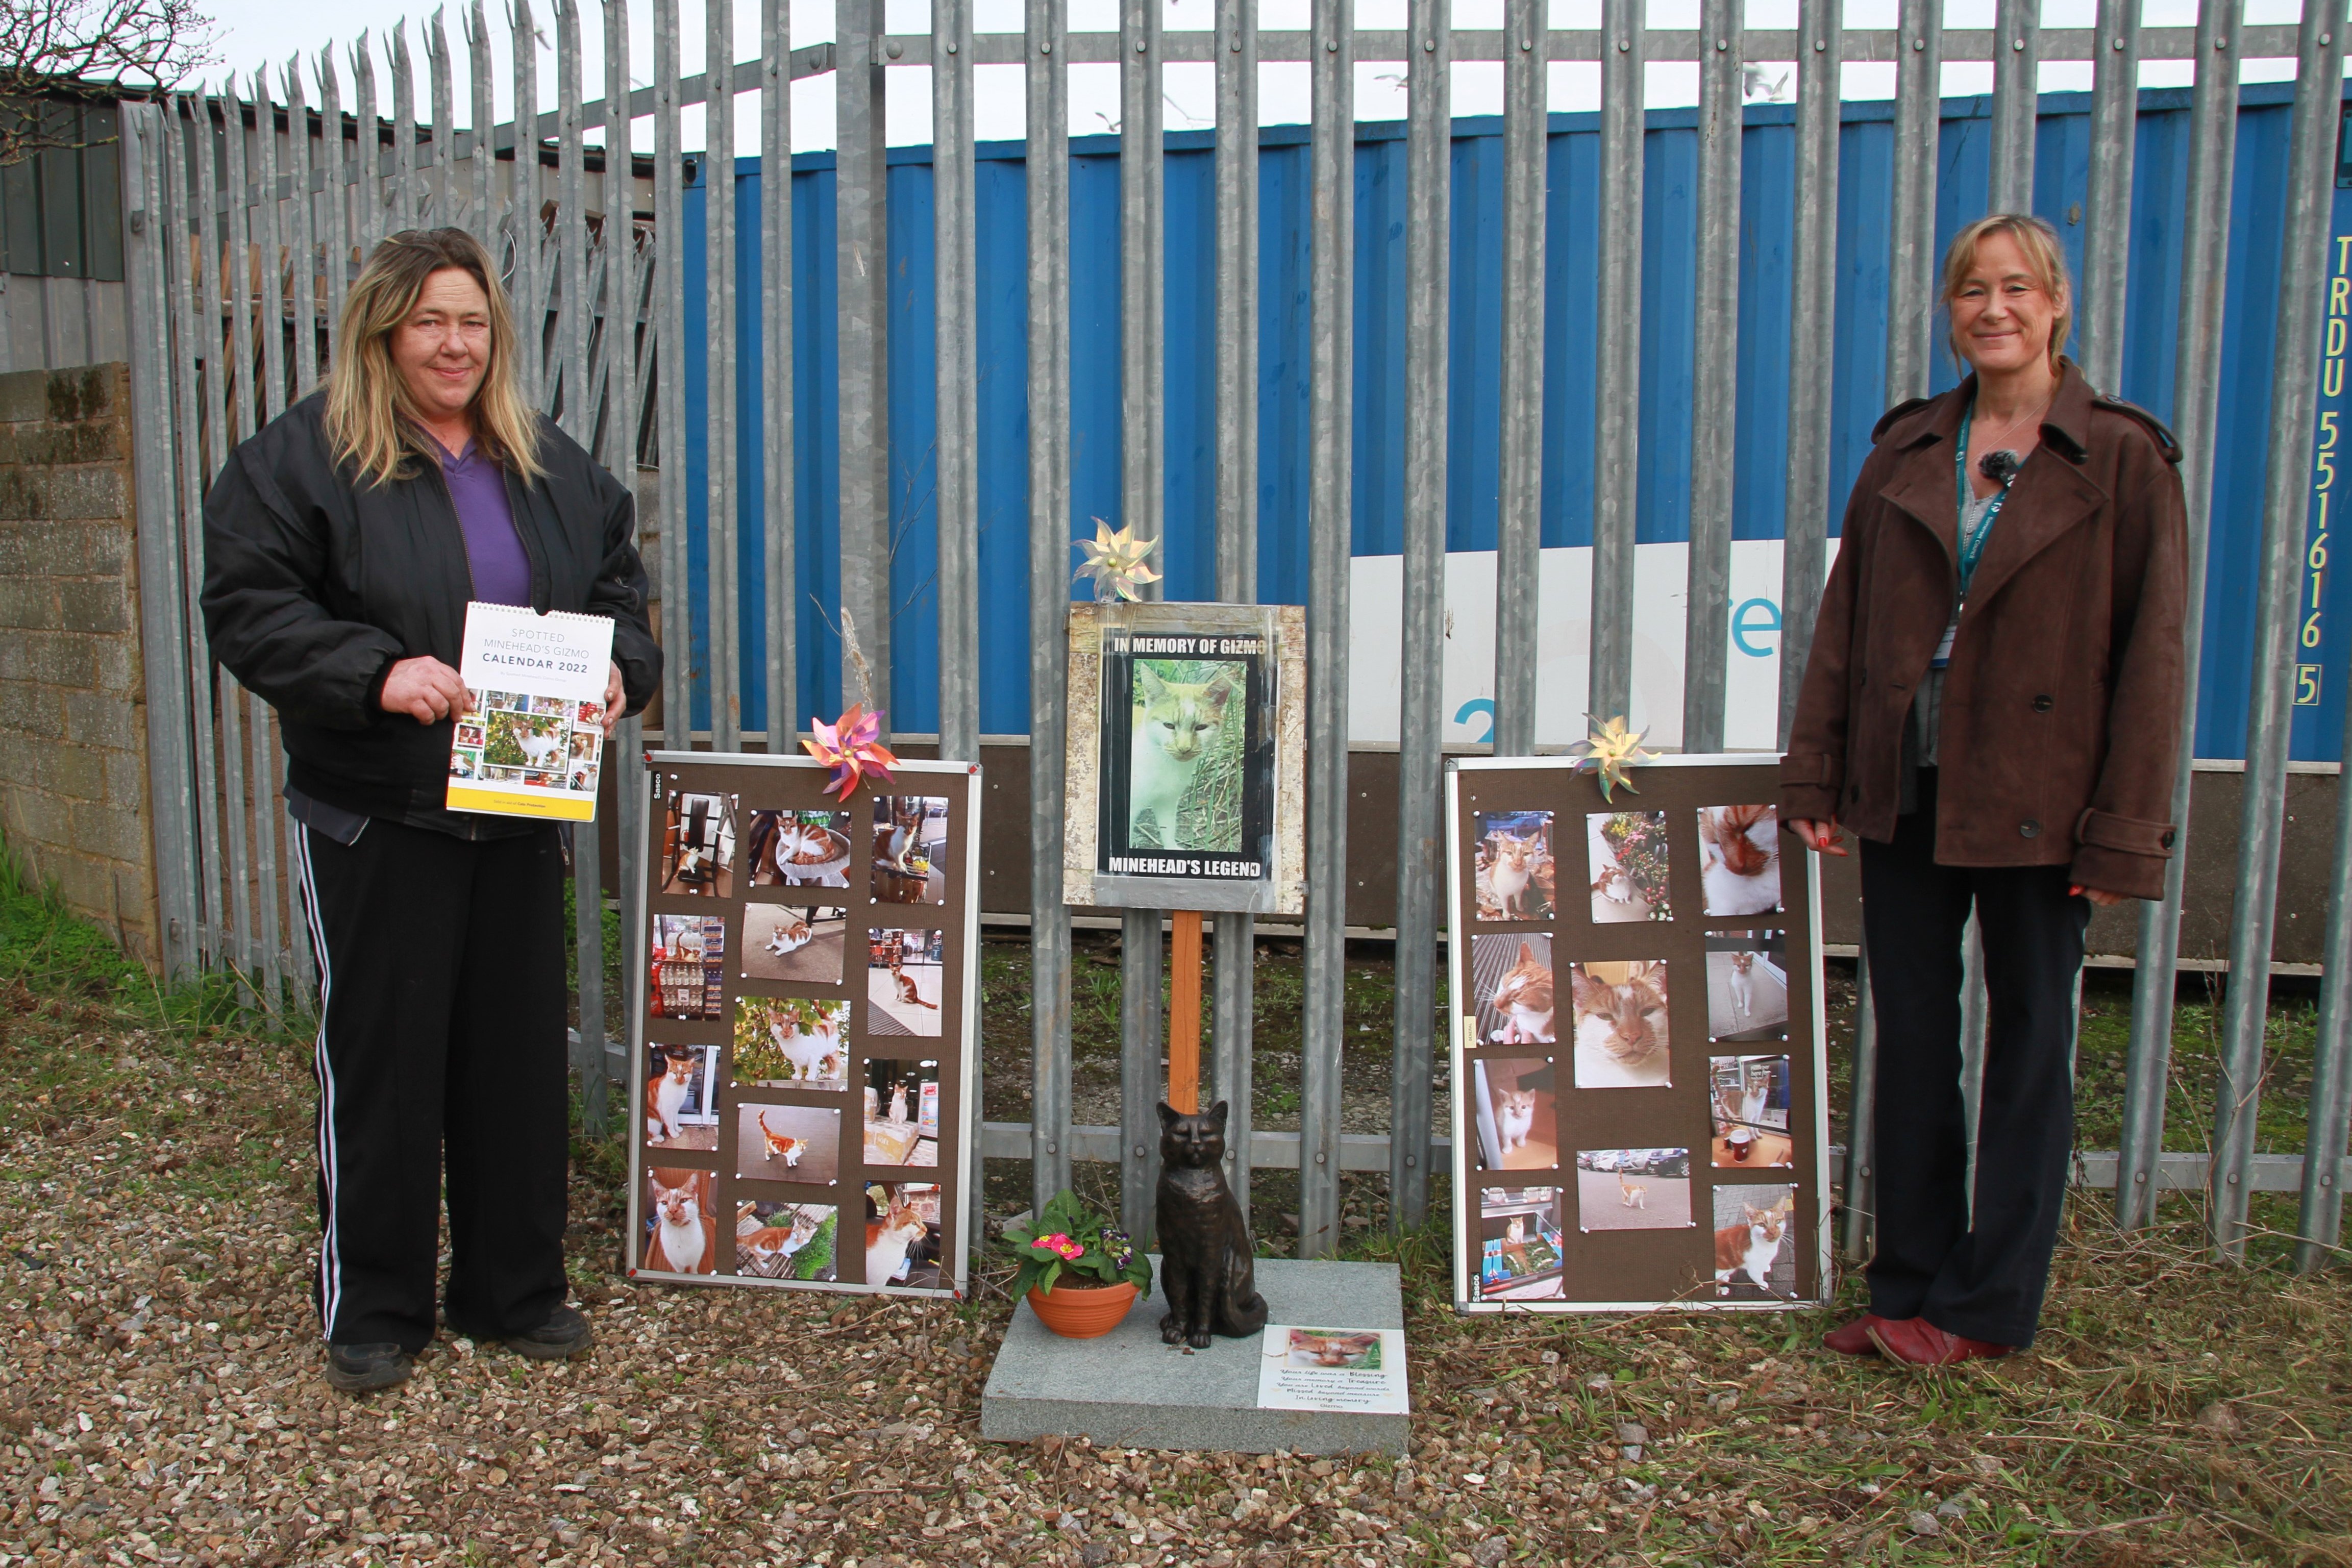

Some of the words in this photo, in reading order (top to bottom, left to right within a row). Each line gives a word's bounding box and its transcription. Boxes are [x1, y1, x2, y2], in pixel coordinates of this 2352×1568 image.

[2323, 236, 2352, 397] TRDU
[1978, 516, 1993, 539] Somerset
[2301, 411, 2339, 648] 551616
[1969, 539, 1980, 559] Council
[512, 628, 565, 642] SPOTTED
[484, 638, 550, 654] MINEHEAD'S
[554, 646, 589, 659] GIZMO
[1114, 638, 1129, 652] IN
[1133, 638, 1196, 654] MEMORY
[1199, 639, 1217, 654] OF
[1220, 639, 1267, 655] GIZMO
[483, 653, 553, 669] CALENDAR
[559, 662, 588, 673] 2022
[2297, 667, 2316, 703] 5
[1108, 857, 1200, 875] MINEHEAD'S
[1204, 860, 1261, 877] LEGEND
